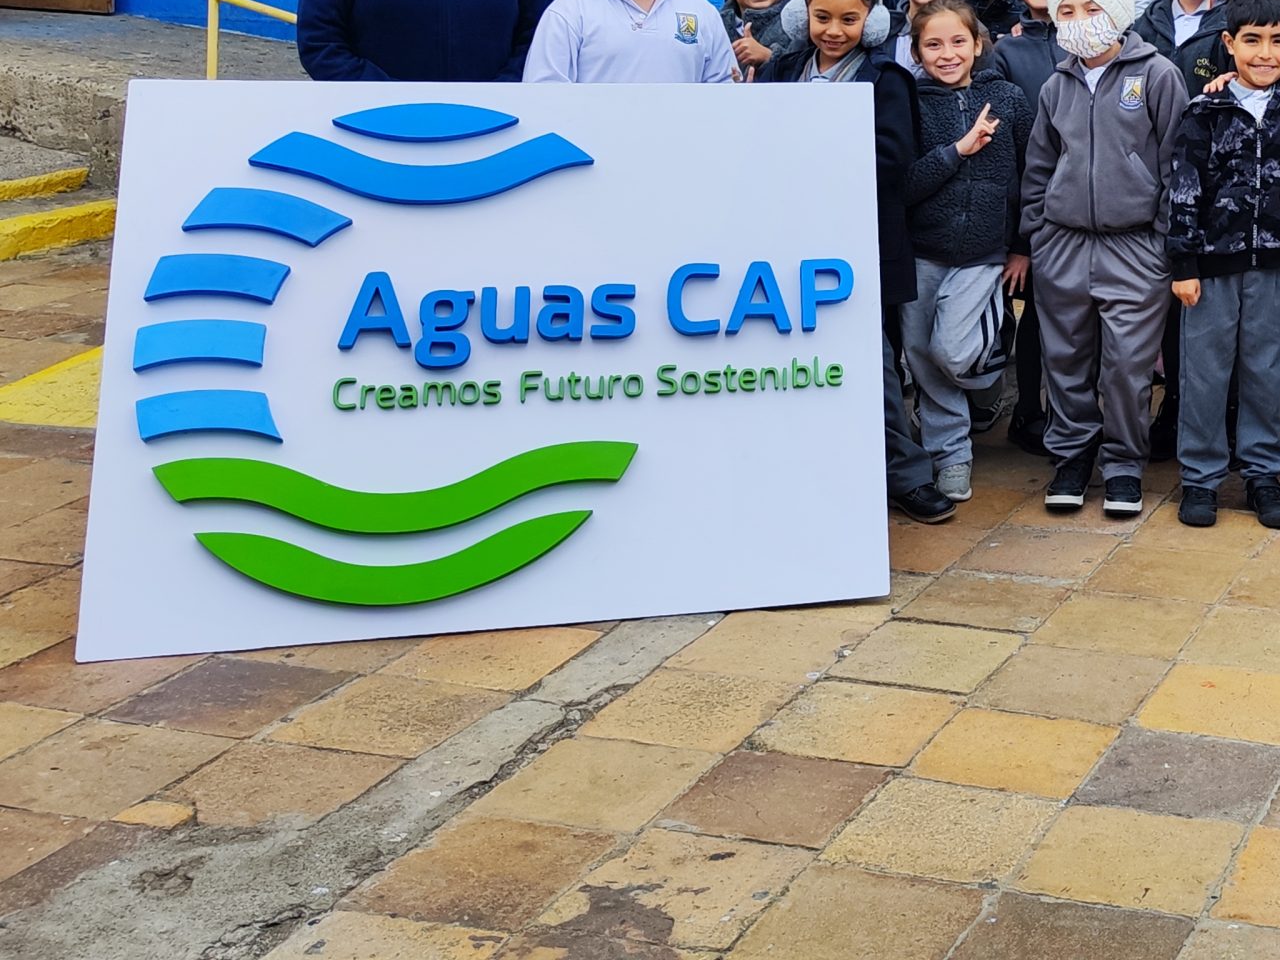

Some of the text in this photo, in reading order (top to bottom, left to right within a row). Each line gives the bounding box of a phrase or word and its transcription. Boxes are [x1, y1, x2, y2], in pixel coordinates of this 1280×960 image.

[337, 258, 854, 370] Aguas CAP
[331, 356, 845, 411] Creamos Futuro Sostenible
